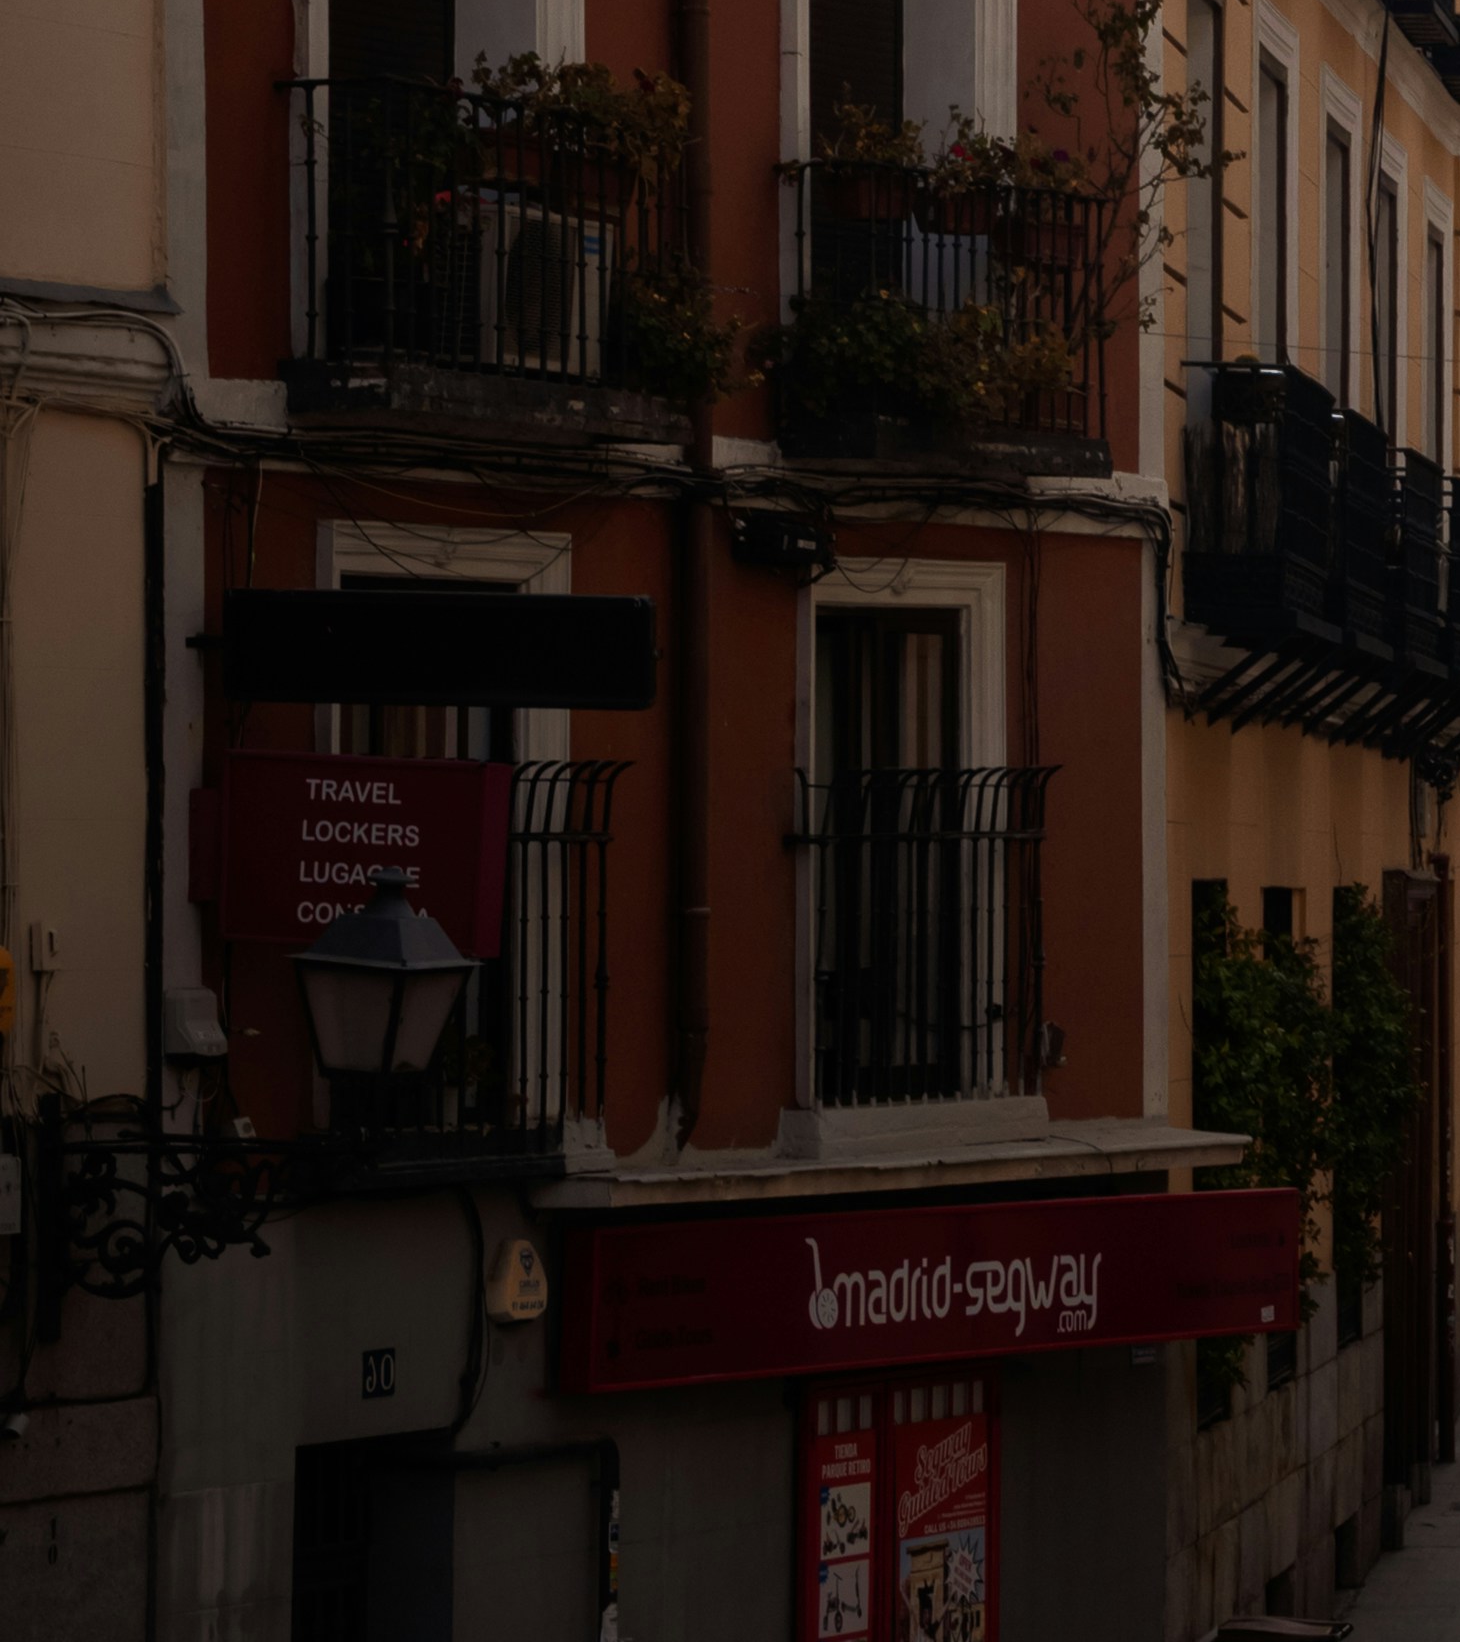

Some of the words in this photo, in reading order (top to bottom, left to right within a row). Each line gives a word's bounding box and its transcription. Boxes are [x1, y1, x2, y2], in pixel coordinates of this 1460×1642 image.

[306, 778, 402, 805] TRAVEL
[301, 818, 420, 847] LOCKERS
[299, 860, 421, 888] LUGAGE
[832, 1251, 1103, 1337] madrid-segway
[1057, 1309, 1087, 1334] .com
[834, 1442, 858, 1460] TIENDA
[914, 1420, 973, 1486] Segway
[821, 1461, 848, 1480] PARQUE
[897, 1476, 951, 1539] Guided
[945, 1442, 988, 1493] Tours
